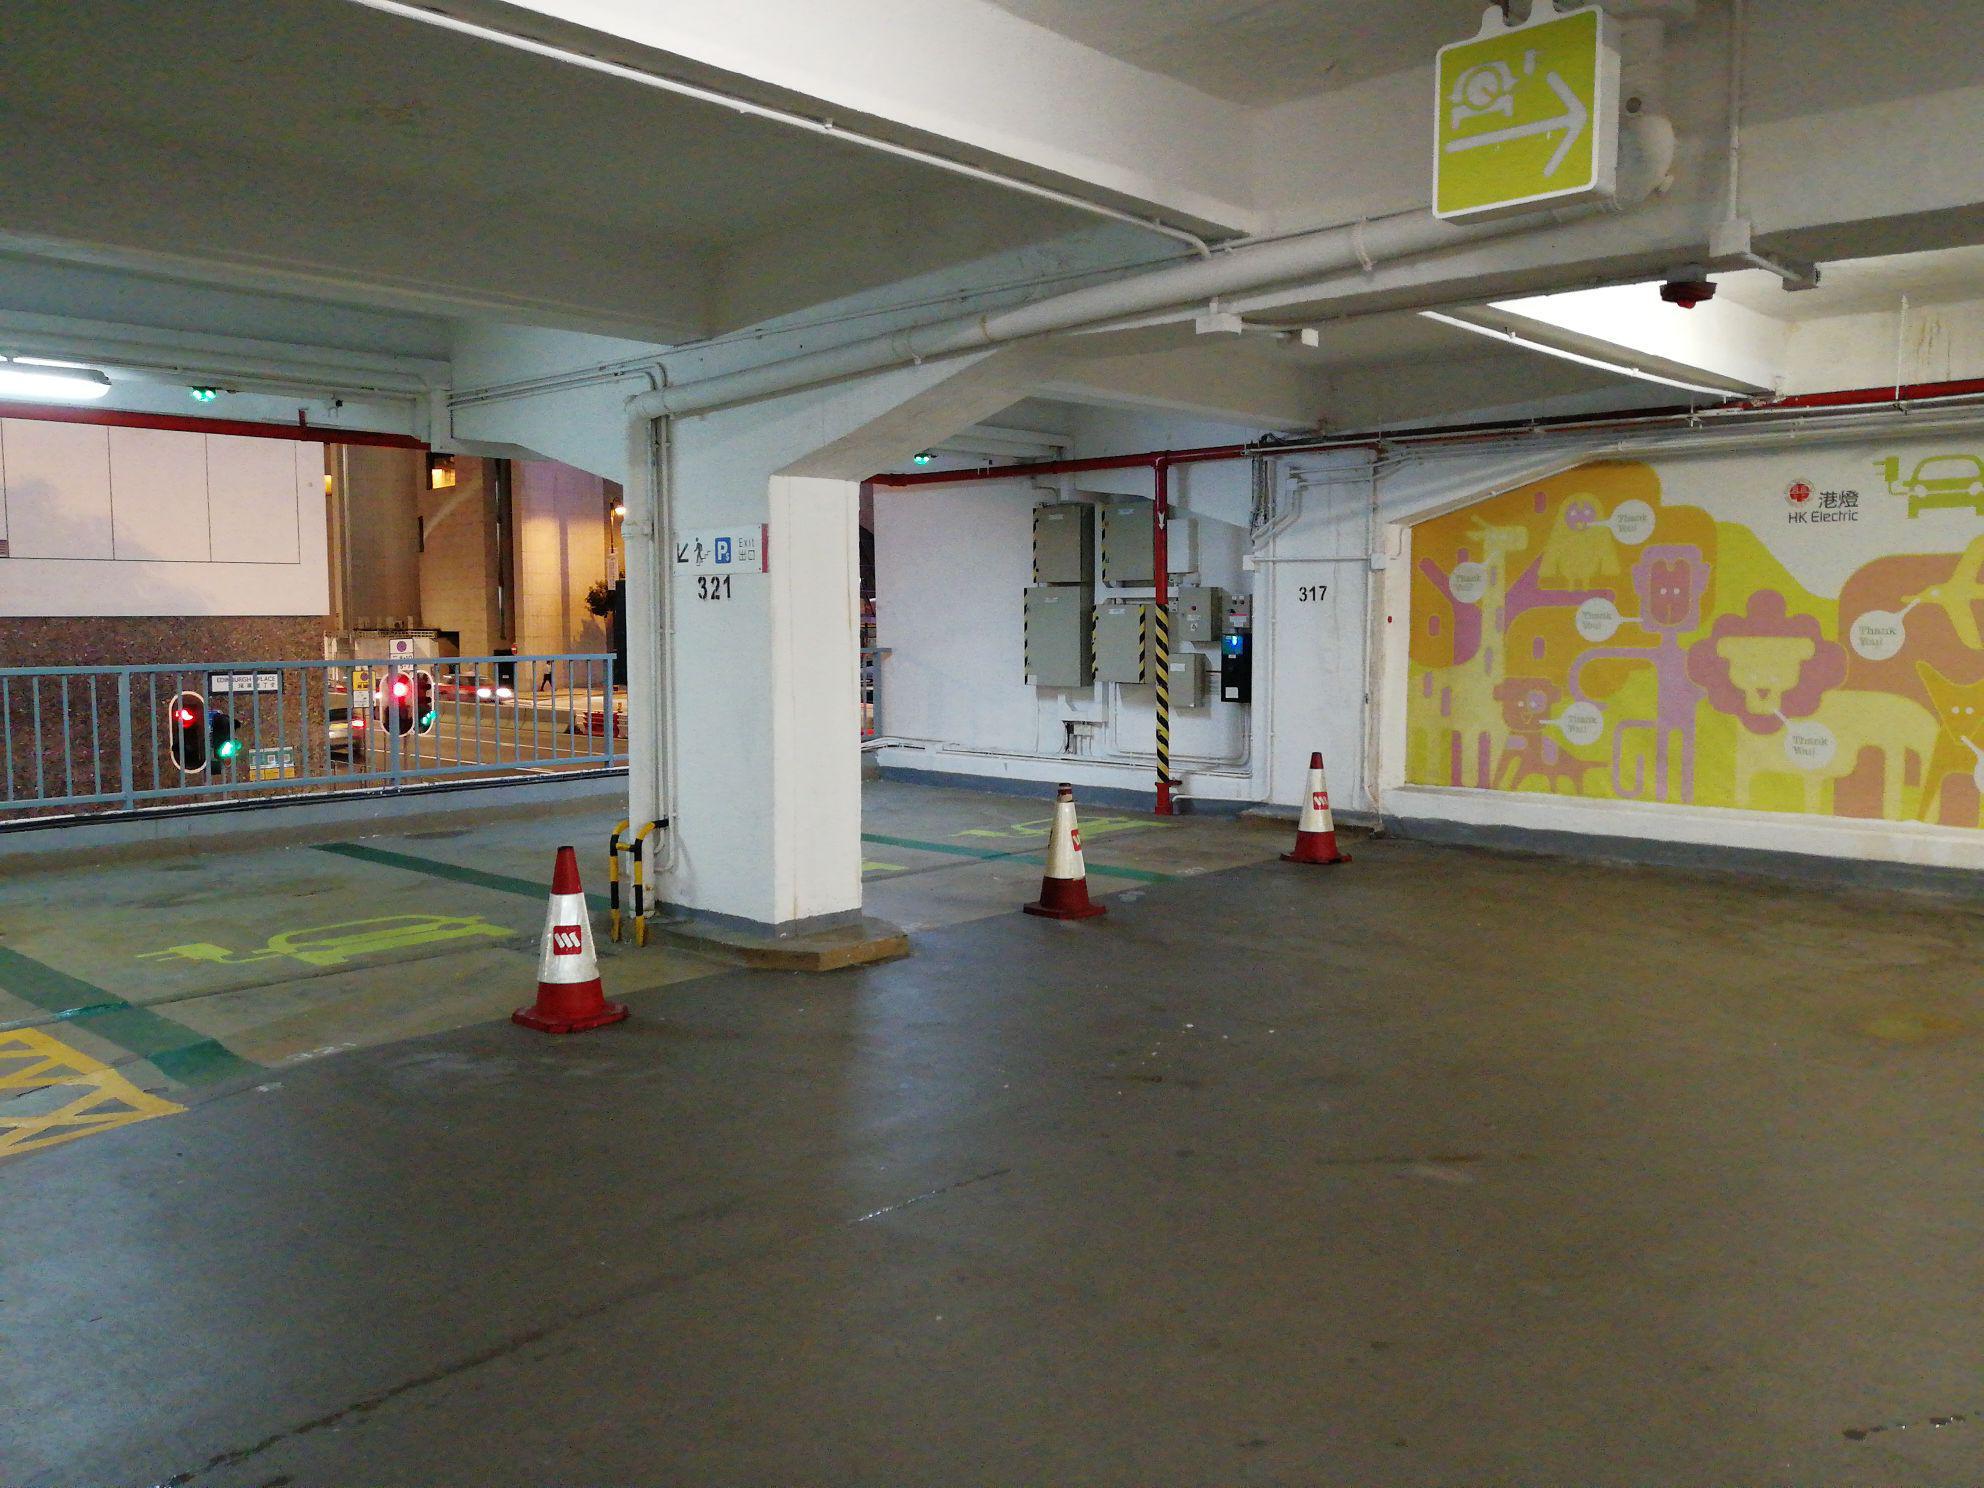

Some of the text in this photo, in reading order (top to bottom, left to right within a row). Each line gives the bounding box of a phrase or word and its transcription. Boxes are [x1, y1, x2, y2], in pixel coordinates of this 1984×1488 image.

[1819, 490, 1858, 508] 港燈
[1788, 510, 1857, 524] HK Electric
[698, 575, 731, 600] 321
[1299, 586, 1327, 601] 317
